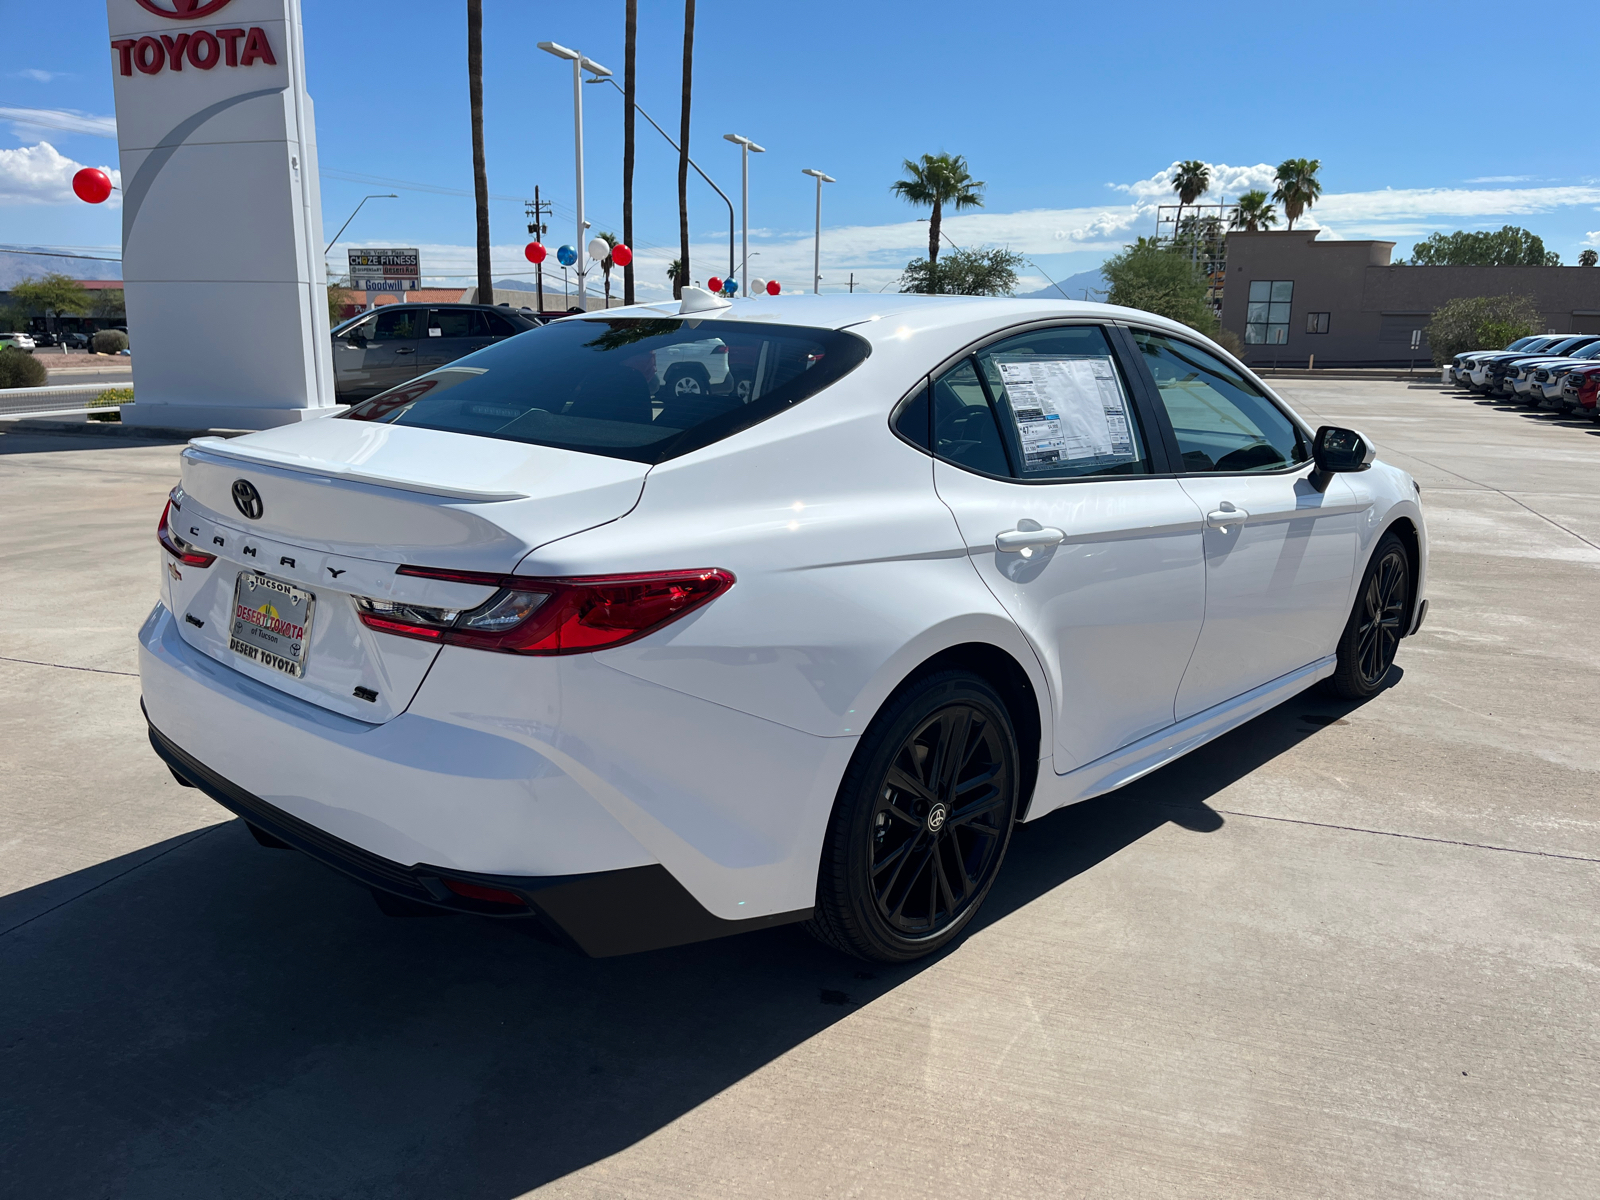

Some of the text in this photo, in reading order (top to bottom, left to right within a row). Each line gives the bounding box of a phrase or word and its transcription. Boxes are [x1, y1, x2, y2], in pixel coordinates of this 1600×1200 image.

[111, 27, 277, 77] TOYOTA
[381, 256, 416, 265] FITNESS
[365, 280, 403, 291] Goodwill
[190, 526, 346, 578] CAMRY
[254, 576, 291, 594] TUCSON
[236, 604, 304, 641] DESERT TOYOTA
[251, 628, 279, 644] of Tucson
[229, 638, 296, 676] DESERT TOYOTA
